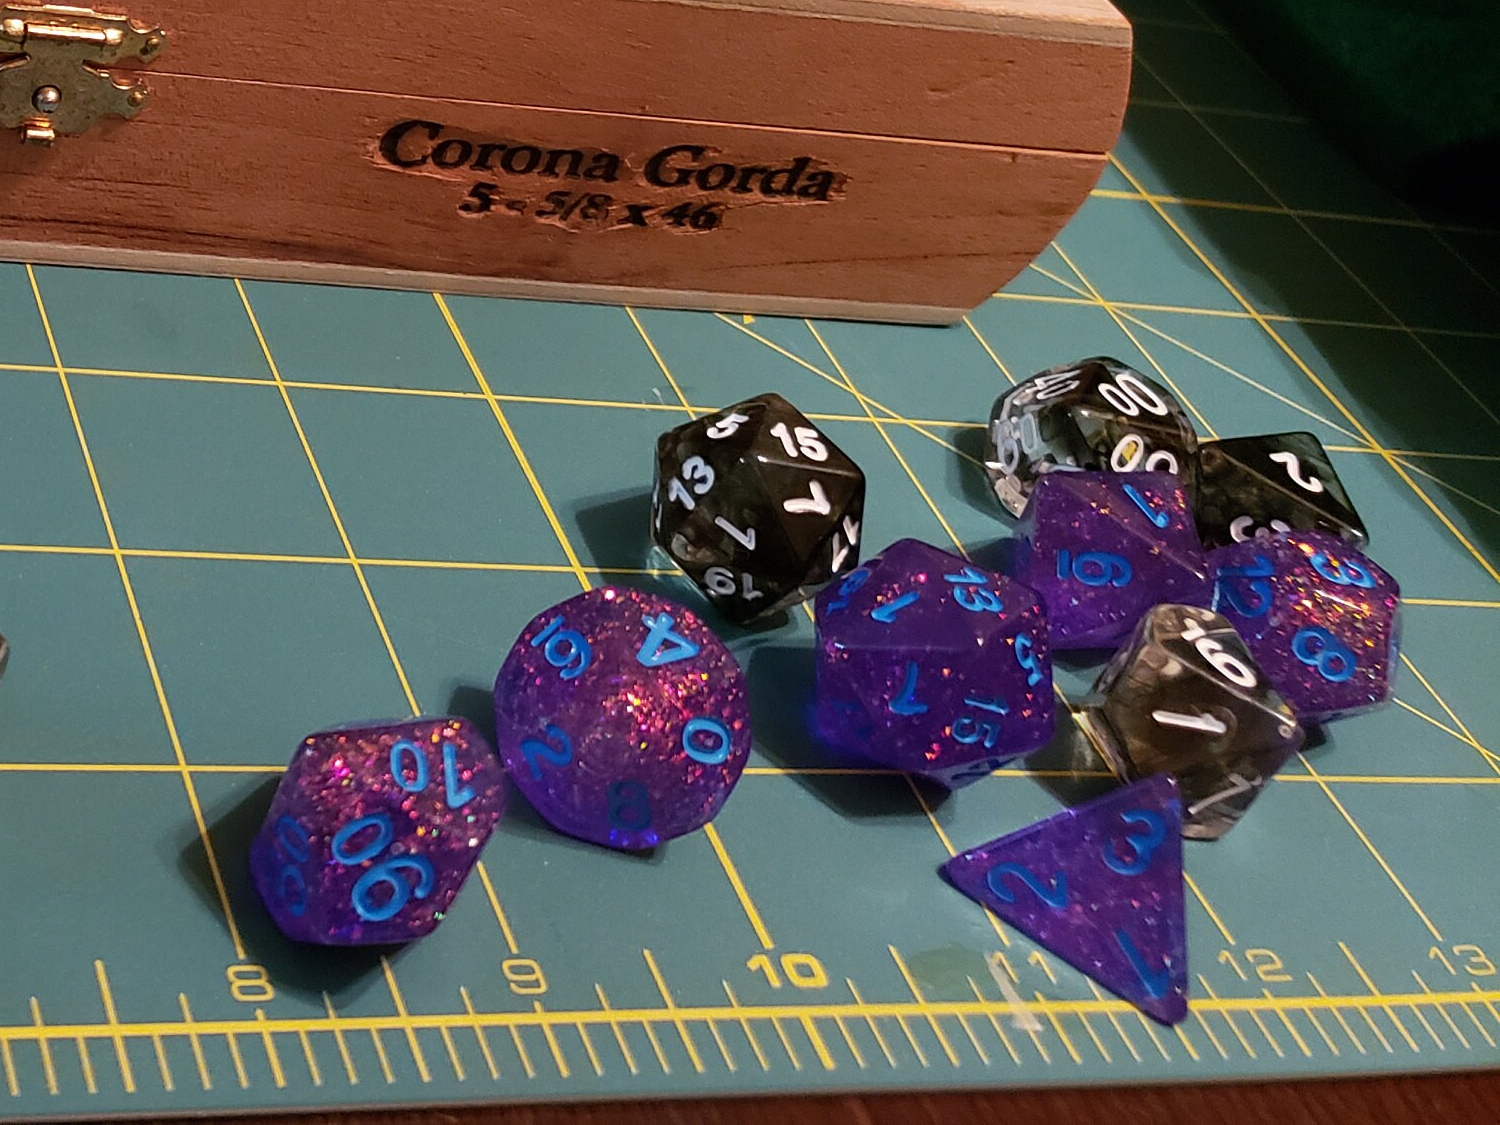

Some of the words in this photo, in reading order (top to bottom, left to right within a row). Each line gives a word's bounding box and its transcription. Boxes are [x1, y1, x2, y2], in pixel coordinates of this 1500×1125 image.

[378, 118, 622, 182] Corona
[644, 144, 840, 202] Gorda
[457, 182, 499, 214] 5
[706, 413, 749, 440] 5
[770, 422, 829, 462] 15
[668, 455, 715, 511] 13
[944, 566, 1004, 613] 13
[635, 612, 700, 670] 4
[1291, 626, 1358, 683] 8
[681, 715, 733, 767] 0
[952, 696, 1009, 749] 15
[389, 739, 476, 810] 10
[518, 722, 574, 780] 2
[1102, 808, 1168, 876] 3
[986, 862, 1068, 909] 2
[225, 964, 276, 1003] 8
[500, 957, 549, 996] 9
[746, 953, 829, 988] 10
[1217, 948, 1294, 983] 12
[1428, 943, 1498, 977] 13
